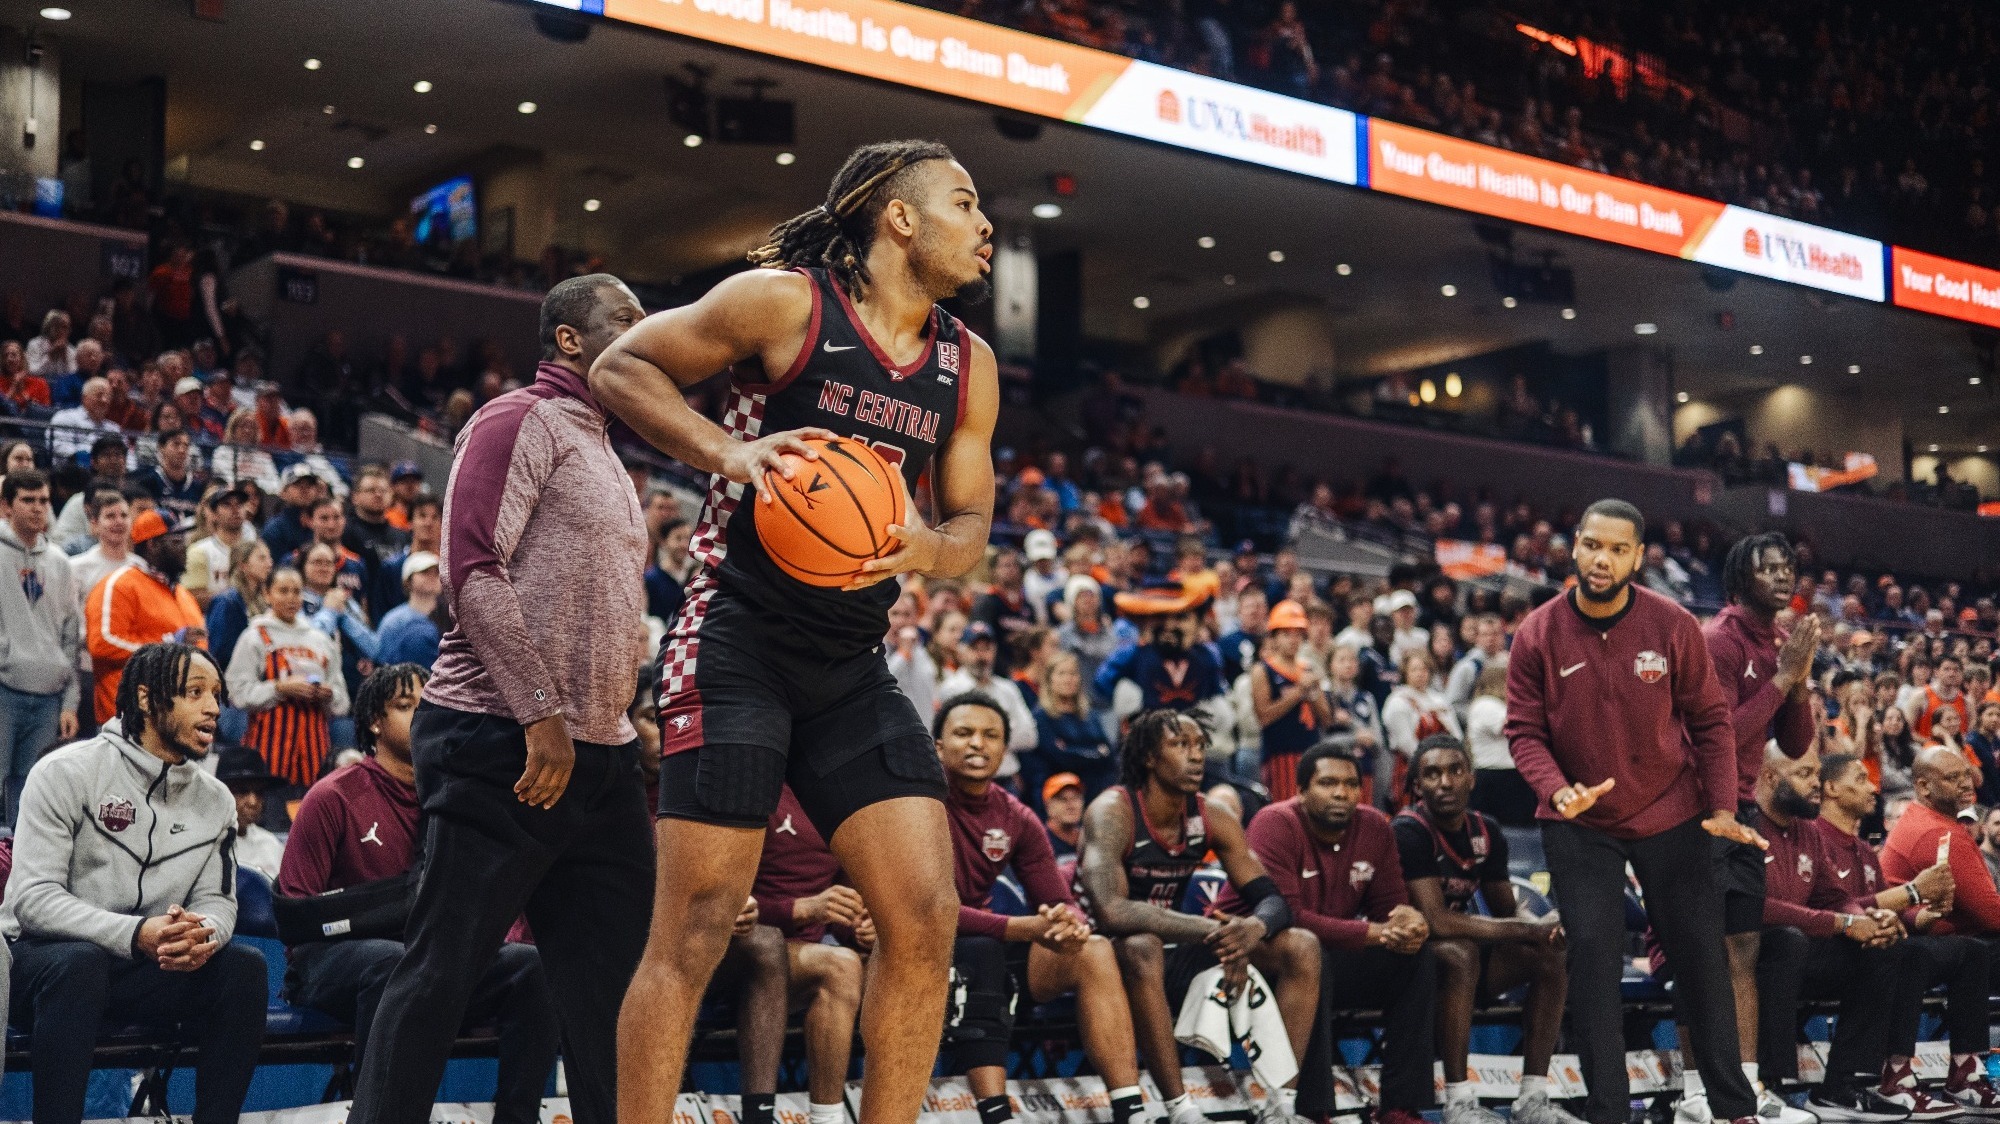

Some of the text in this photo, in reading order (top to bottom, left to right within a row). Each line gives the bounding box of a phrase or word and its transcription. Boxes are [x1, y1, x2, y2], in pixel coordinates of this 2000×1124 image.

[769, 0, 857, 44] Health
[861, 17, 888, 52] Is
[889, 25, 937, 63] Our
[939, 36, 1004, 78] Slam
[1006, 52, 1071, 95] Dunk
[1379, 139, 1684, 238] Your Good Health Is Our Slam Dunk
[1901, 264, 1933, 294] Your
[1935, 273, 1969, 302] Good
[818, 380, 940, 443] NC CENTRAL
